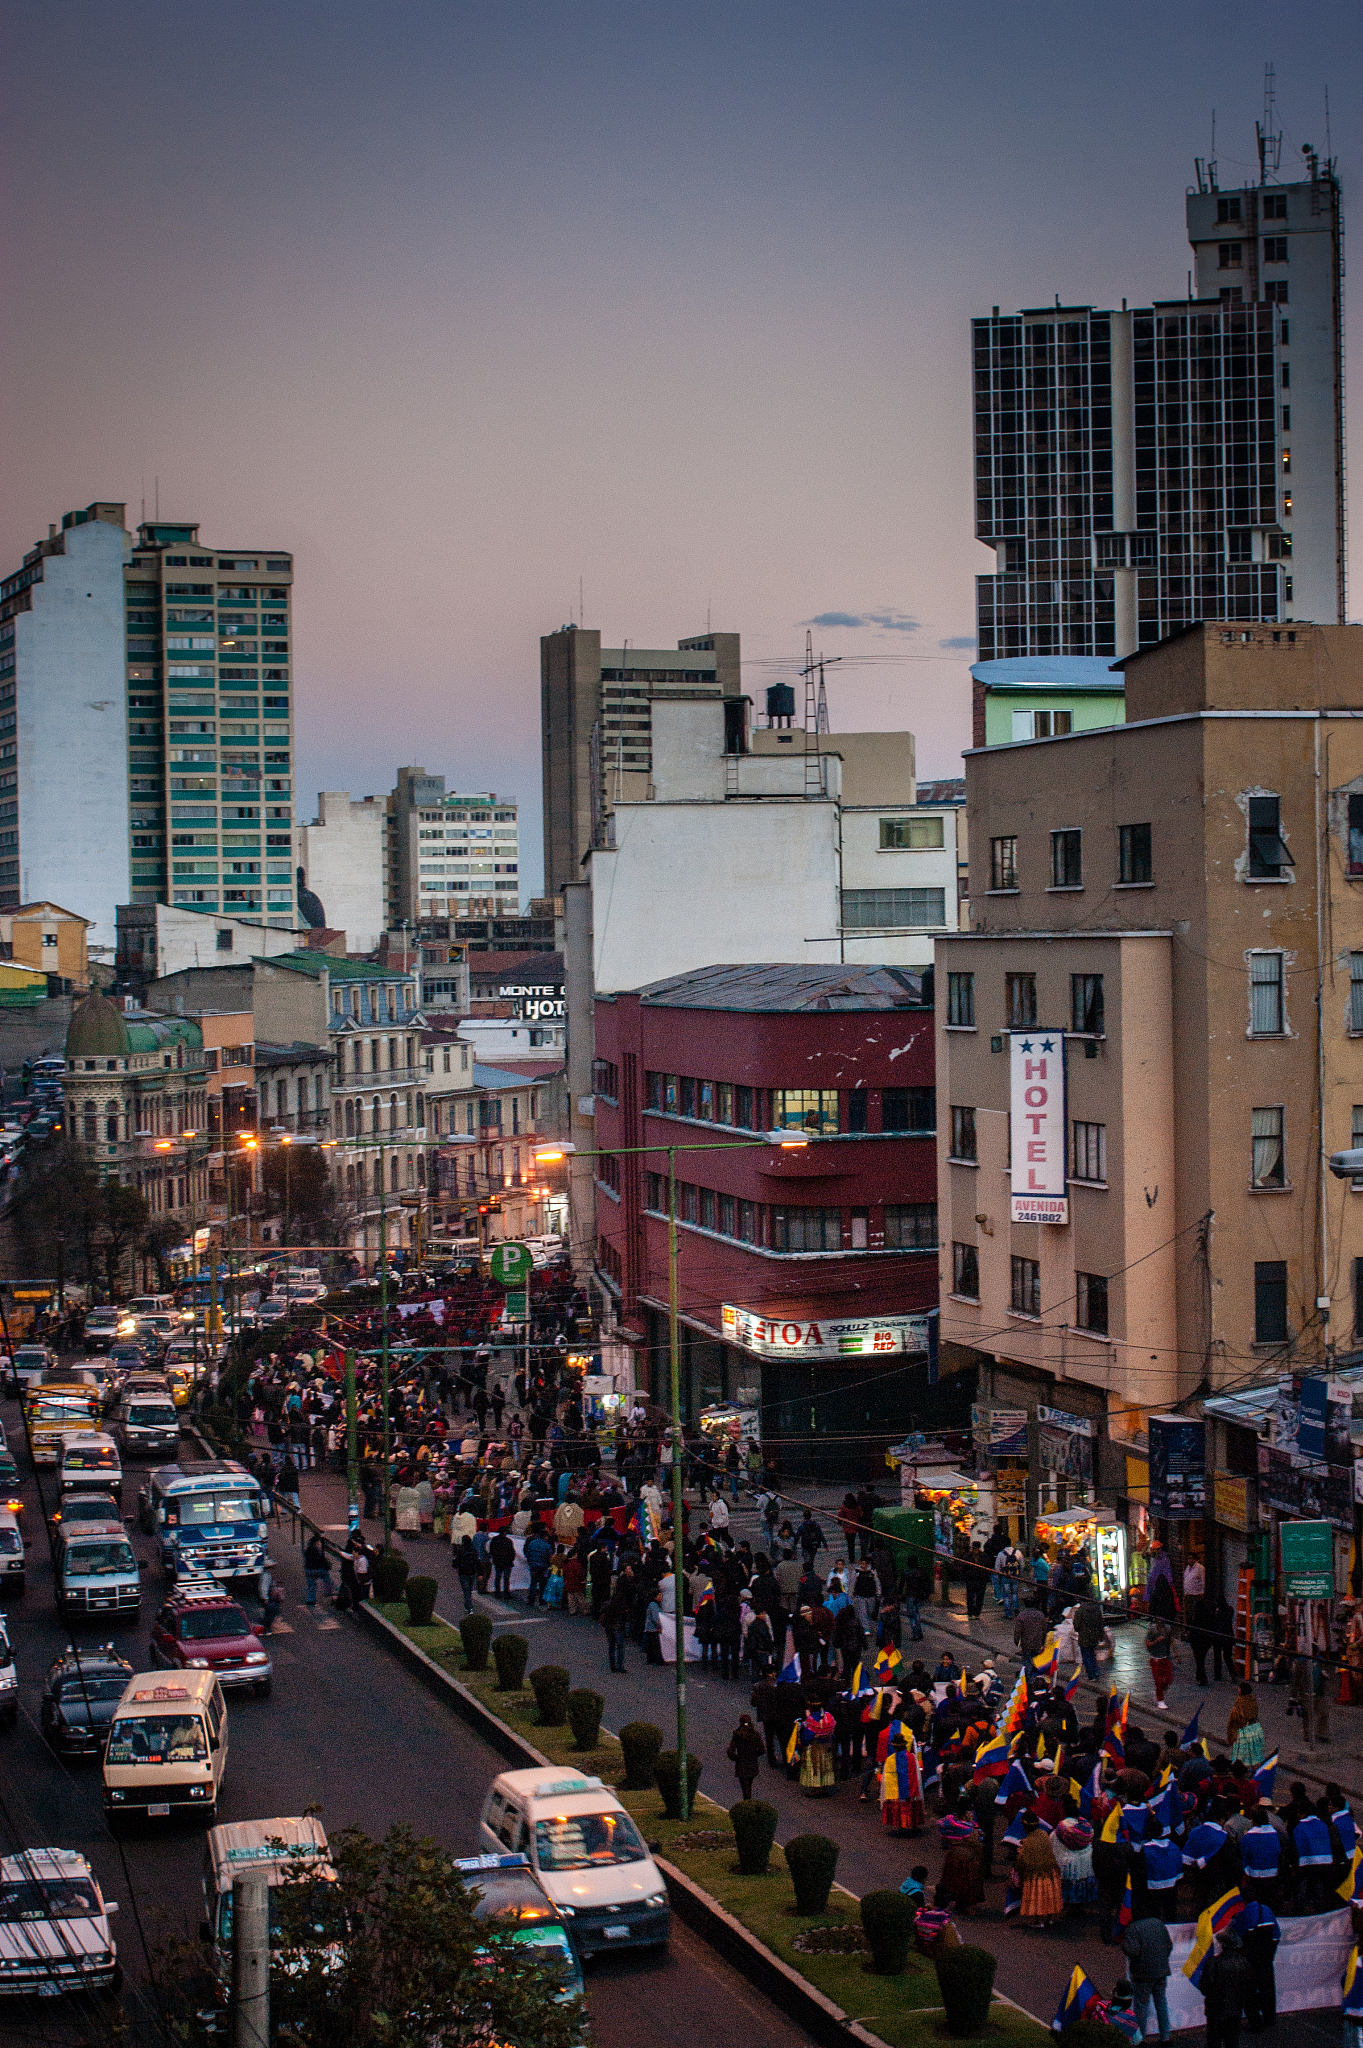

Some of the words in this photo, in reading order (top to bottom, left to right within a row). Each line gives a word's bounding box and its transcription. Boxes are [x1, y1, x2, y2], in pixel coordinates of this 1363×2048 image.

[499, 986, 555, 996] MONTE
[1024, 1058, 1049, 1190] HOTEL
[1015, 1200, 1065, 1213] AVENIDA
[1017, 1212, 1062, 1222] 2461802
[503, 1246, 521, 1272] P
[829, 1323, 870, 1333] SCHULZ
[874, 1332, 892, 1341] BIG
[873, 1341, 894, 1351] RED
